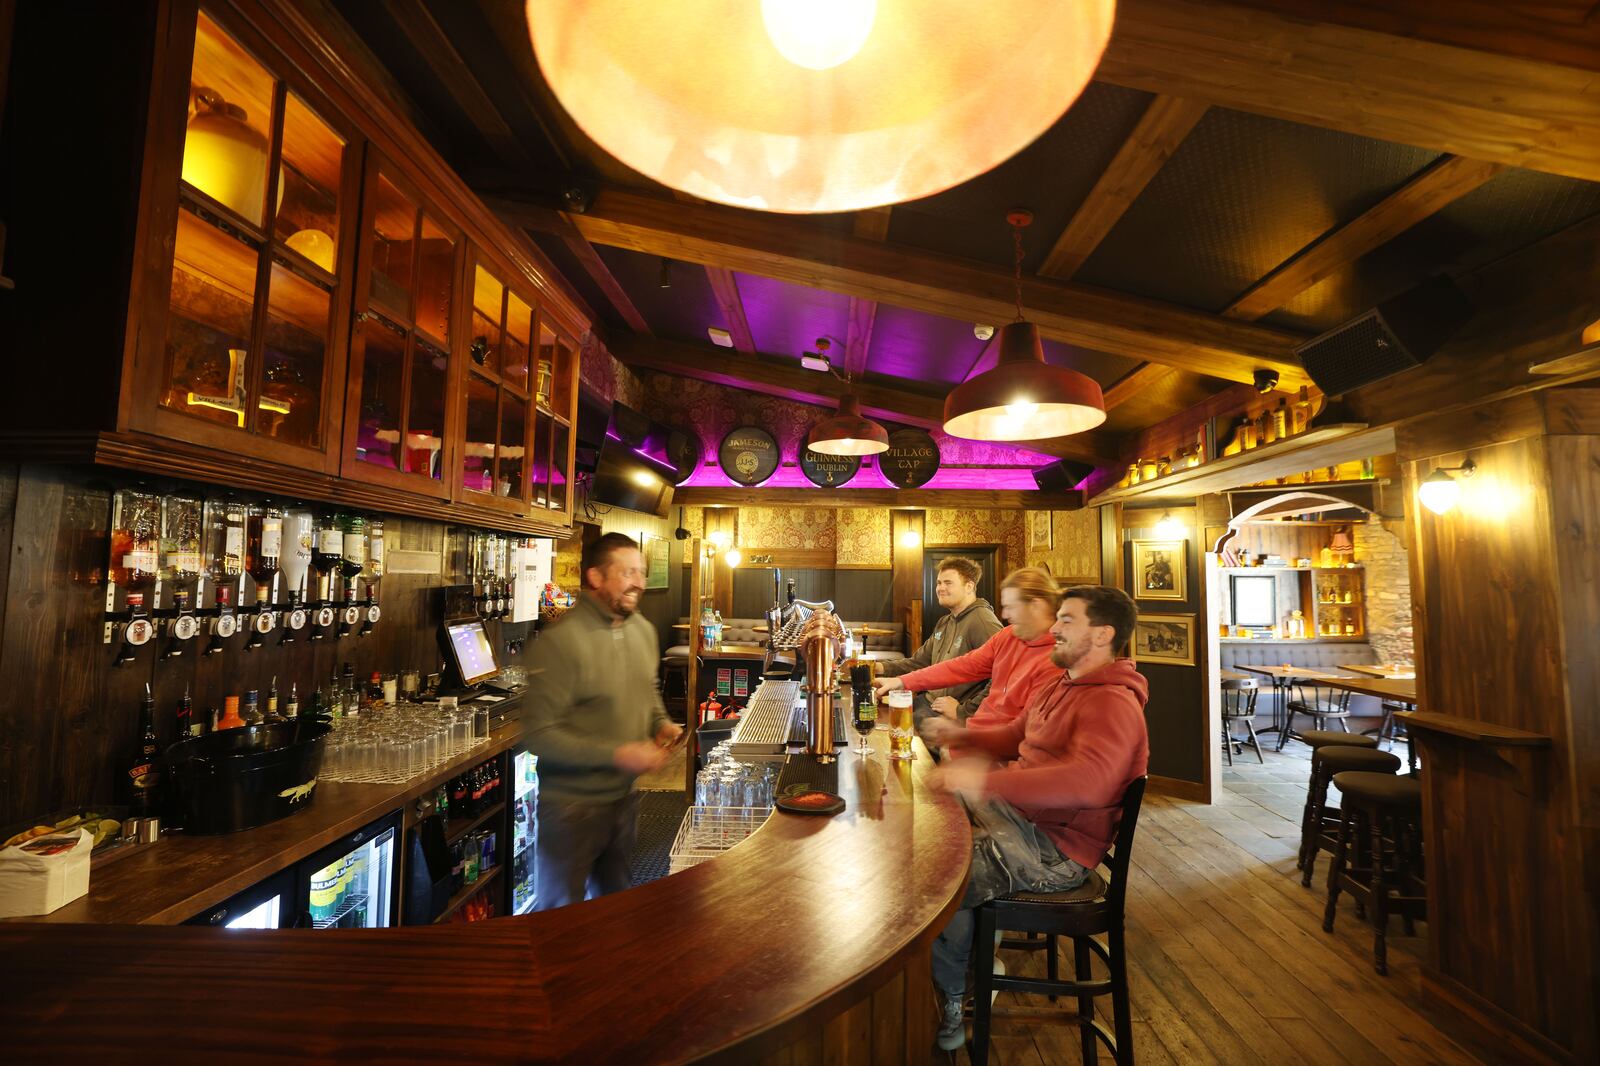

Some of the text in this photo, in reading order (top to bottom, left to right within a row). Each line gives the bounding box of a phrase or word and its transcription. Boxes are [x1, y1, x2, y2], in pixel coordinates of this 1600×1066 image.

[728, 439, 771, 450] JAMESON
[805, 451, 855, 463] GUINNESS
[886, 447, 932, 457] VILLAGE
[898, 460, 920, 468] TAP
